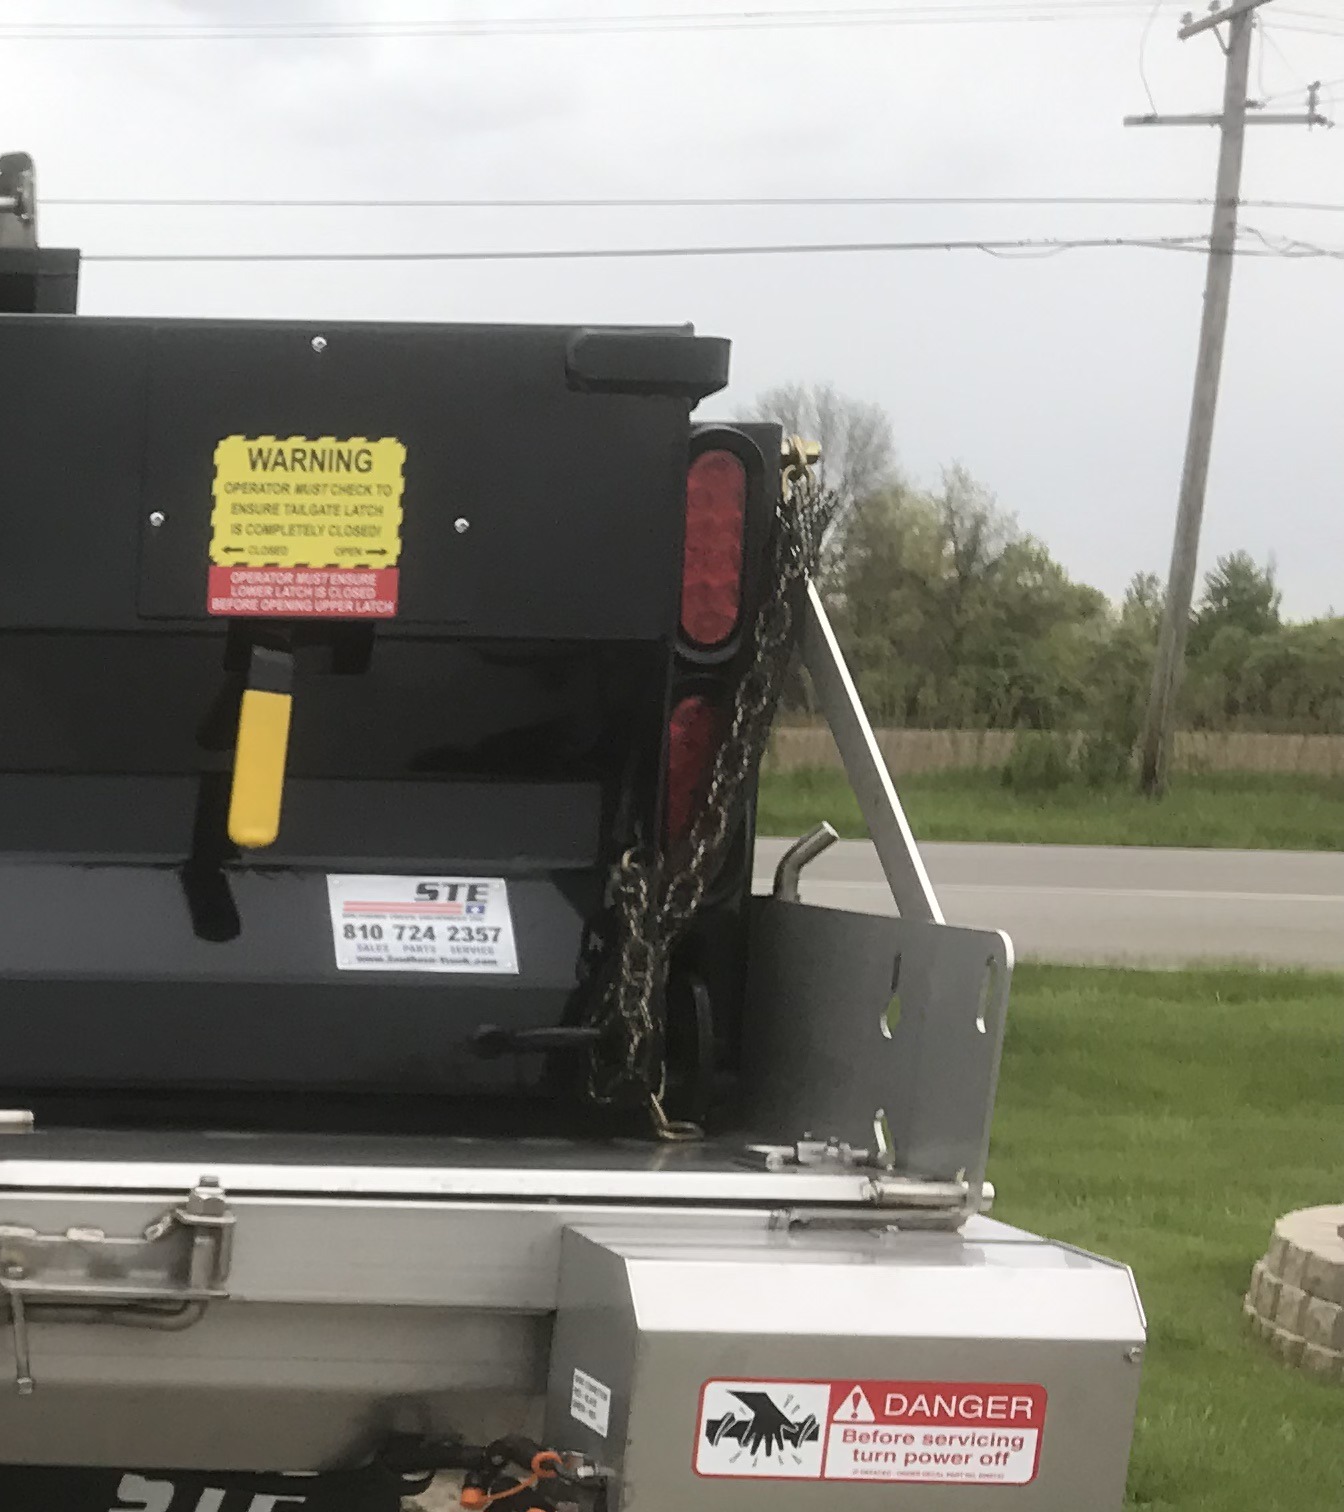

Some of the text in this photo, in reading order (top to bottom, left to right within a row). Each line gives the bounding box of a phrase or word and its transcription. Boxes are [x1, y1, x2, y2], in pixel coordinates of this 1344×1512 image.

[247, 447, 373, 473] WARNING
[224, 481, 393, 497] OPERATOR MUST CHECK TO
[231, 502, 384, 518] ENSURE TAILGATE LATCH
[231, 523, 242, 536] IS
[245, 523, 326, 537] COMPLETELY
[333, 546, 362, 557] OPEN
[414, 882, 489, 903] STE
[343, 923, 502, 943] 810 724 2357
[884, 1392, 1034, 1420] DANGER
[842, 1428, 1025, 1452] Before servicing
[852, 1449, 1011, 1467] turn power off
